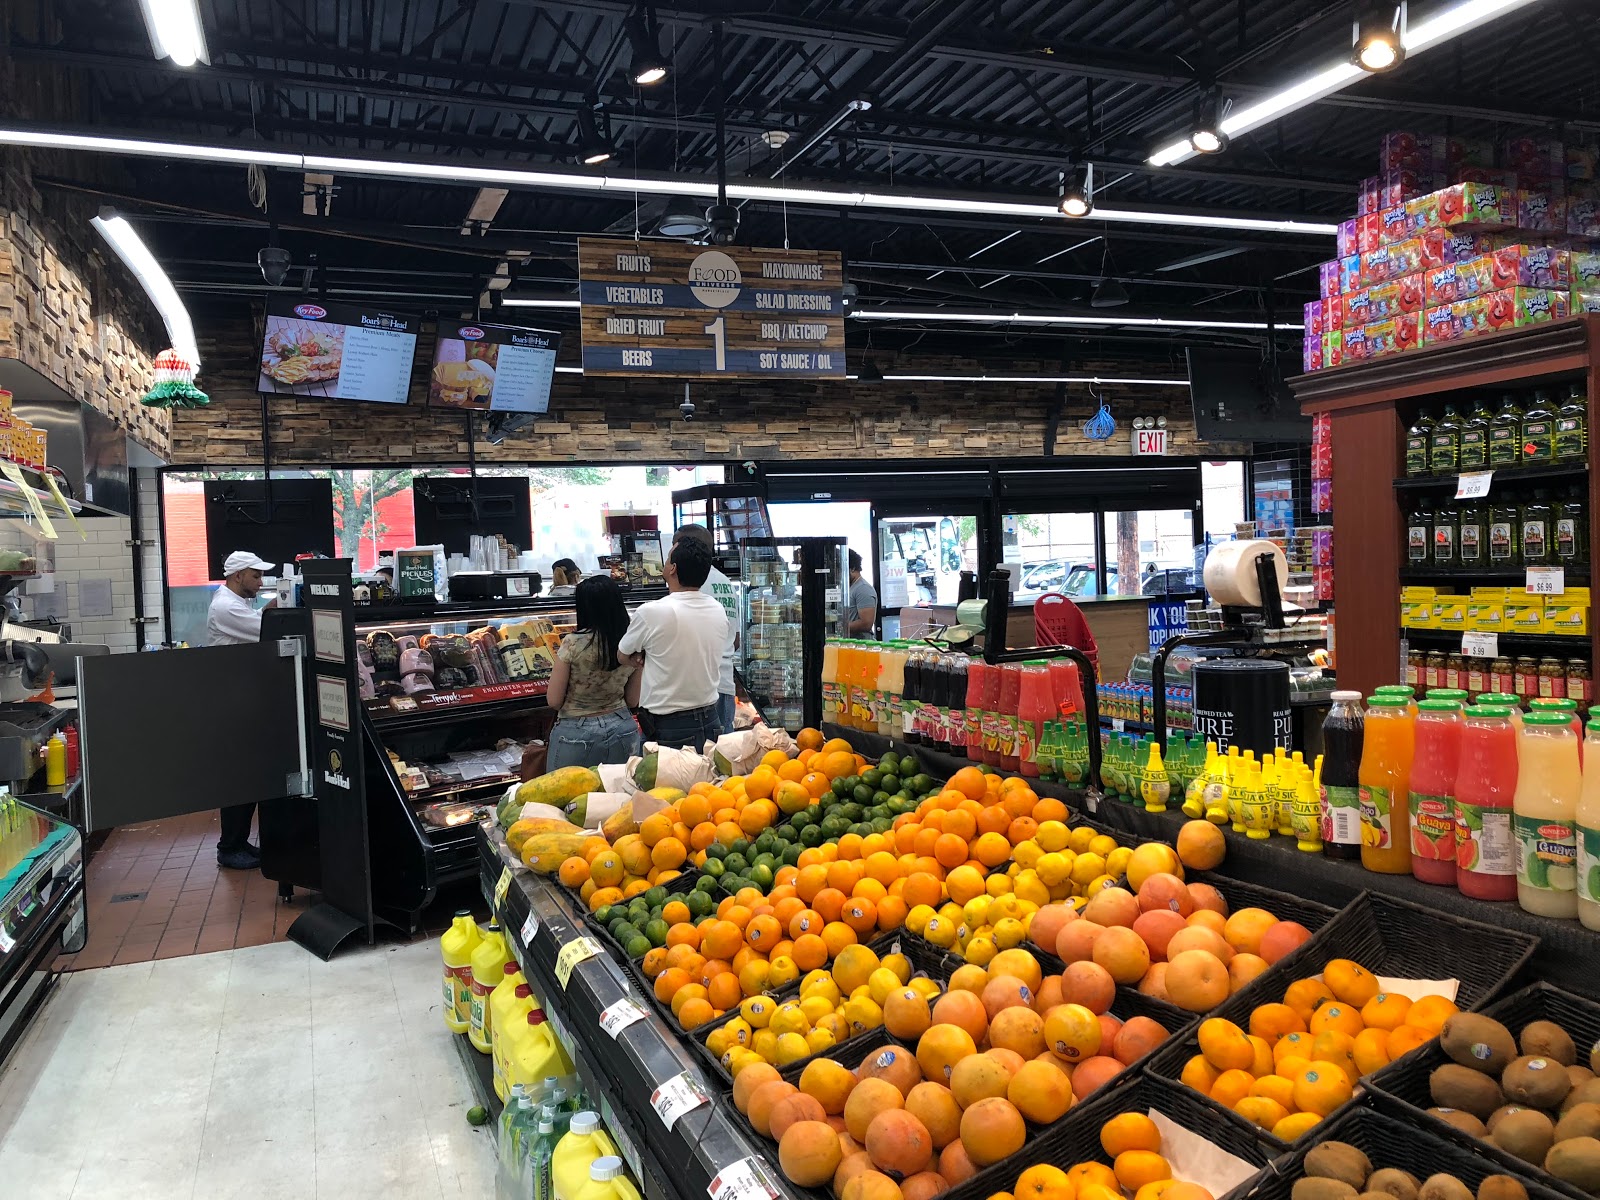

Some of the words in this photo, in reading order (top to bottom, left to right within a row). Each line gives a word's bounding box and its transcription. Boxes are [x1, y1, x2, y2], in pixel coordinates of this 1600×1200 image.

[616, 255, 651, 273] FRUITS
[694, 268, 736, 281] FOOD
[762, 263, 823, 281] MAYONNAISE
[606, 286, 664, 305] VEGETABLES
[756, 293, 785, 309] SALAD
[787, 294, 832, 311] DRESSING
[361, 315, 380, 325] Boar's
[390, 320, 407, 329] Head
[606, 318, 636, 335] DRIED
[638, 319, 665, 336] FRUIT
[761, 323, 780, 339] BBQ
[788, 324, 828, 340] KETCHUP
[512, 335, 527, 343] Boar's
[535, 338, 549, 346] Head
[704, 317, 726, 371] 1
[622, 350, 652, 367] BEERS
[760, 353, 778, 369] SOY
[781, 354, 810, 369] SAUCE
[818, 354, 832, 370] OIL
[1139, 432, 1164, 452] EXIT
[401, 570, 433, 580] PICKLES
[310, 585, 339, 596] WELCOME
[1537, 583, 1552, 592] $6.99
[1473, 647, 1484, 656] $.99
[482, 684, 521, 693] ENLIGHTEN
[337, 774, 350, 789] Head
[1420, 803, 1446, 811] SUNBEST
[1418, 814, 1451, 830] Guava
[1540, 828, 1570, 836] SUNBEST
[1539, 842, 1577, 856] Guava
